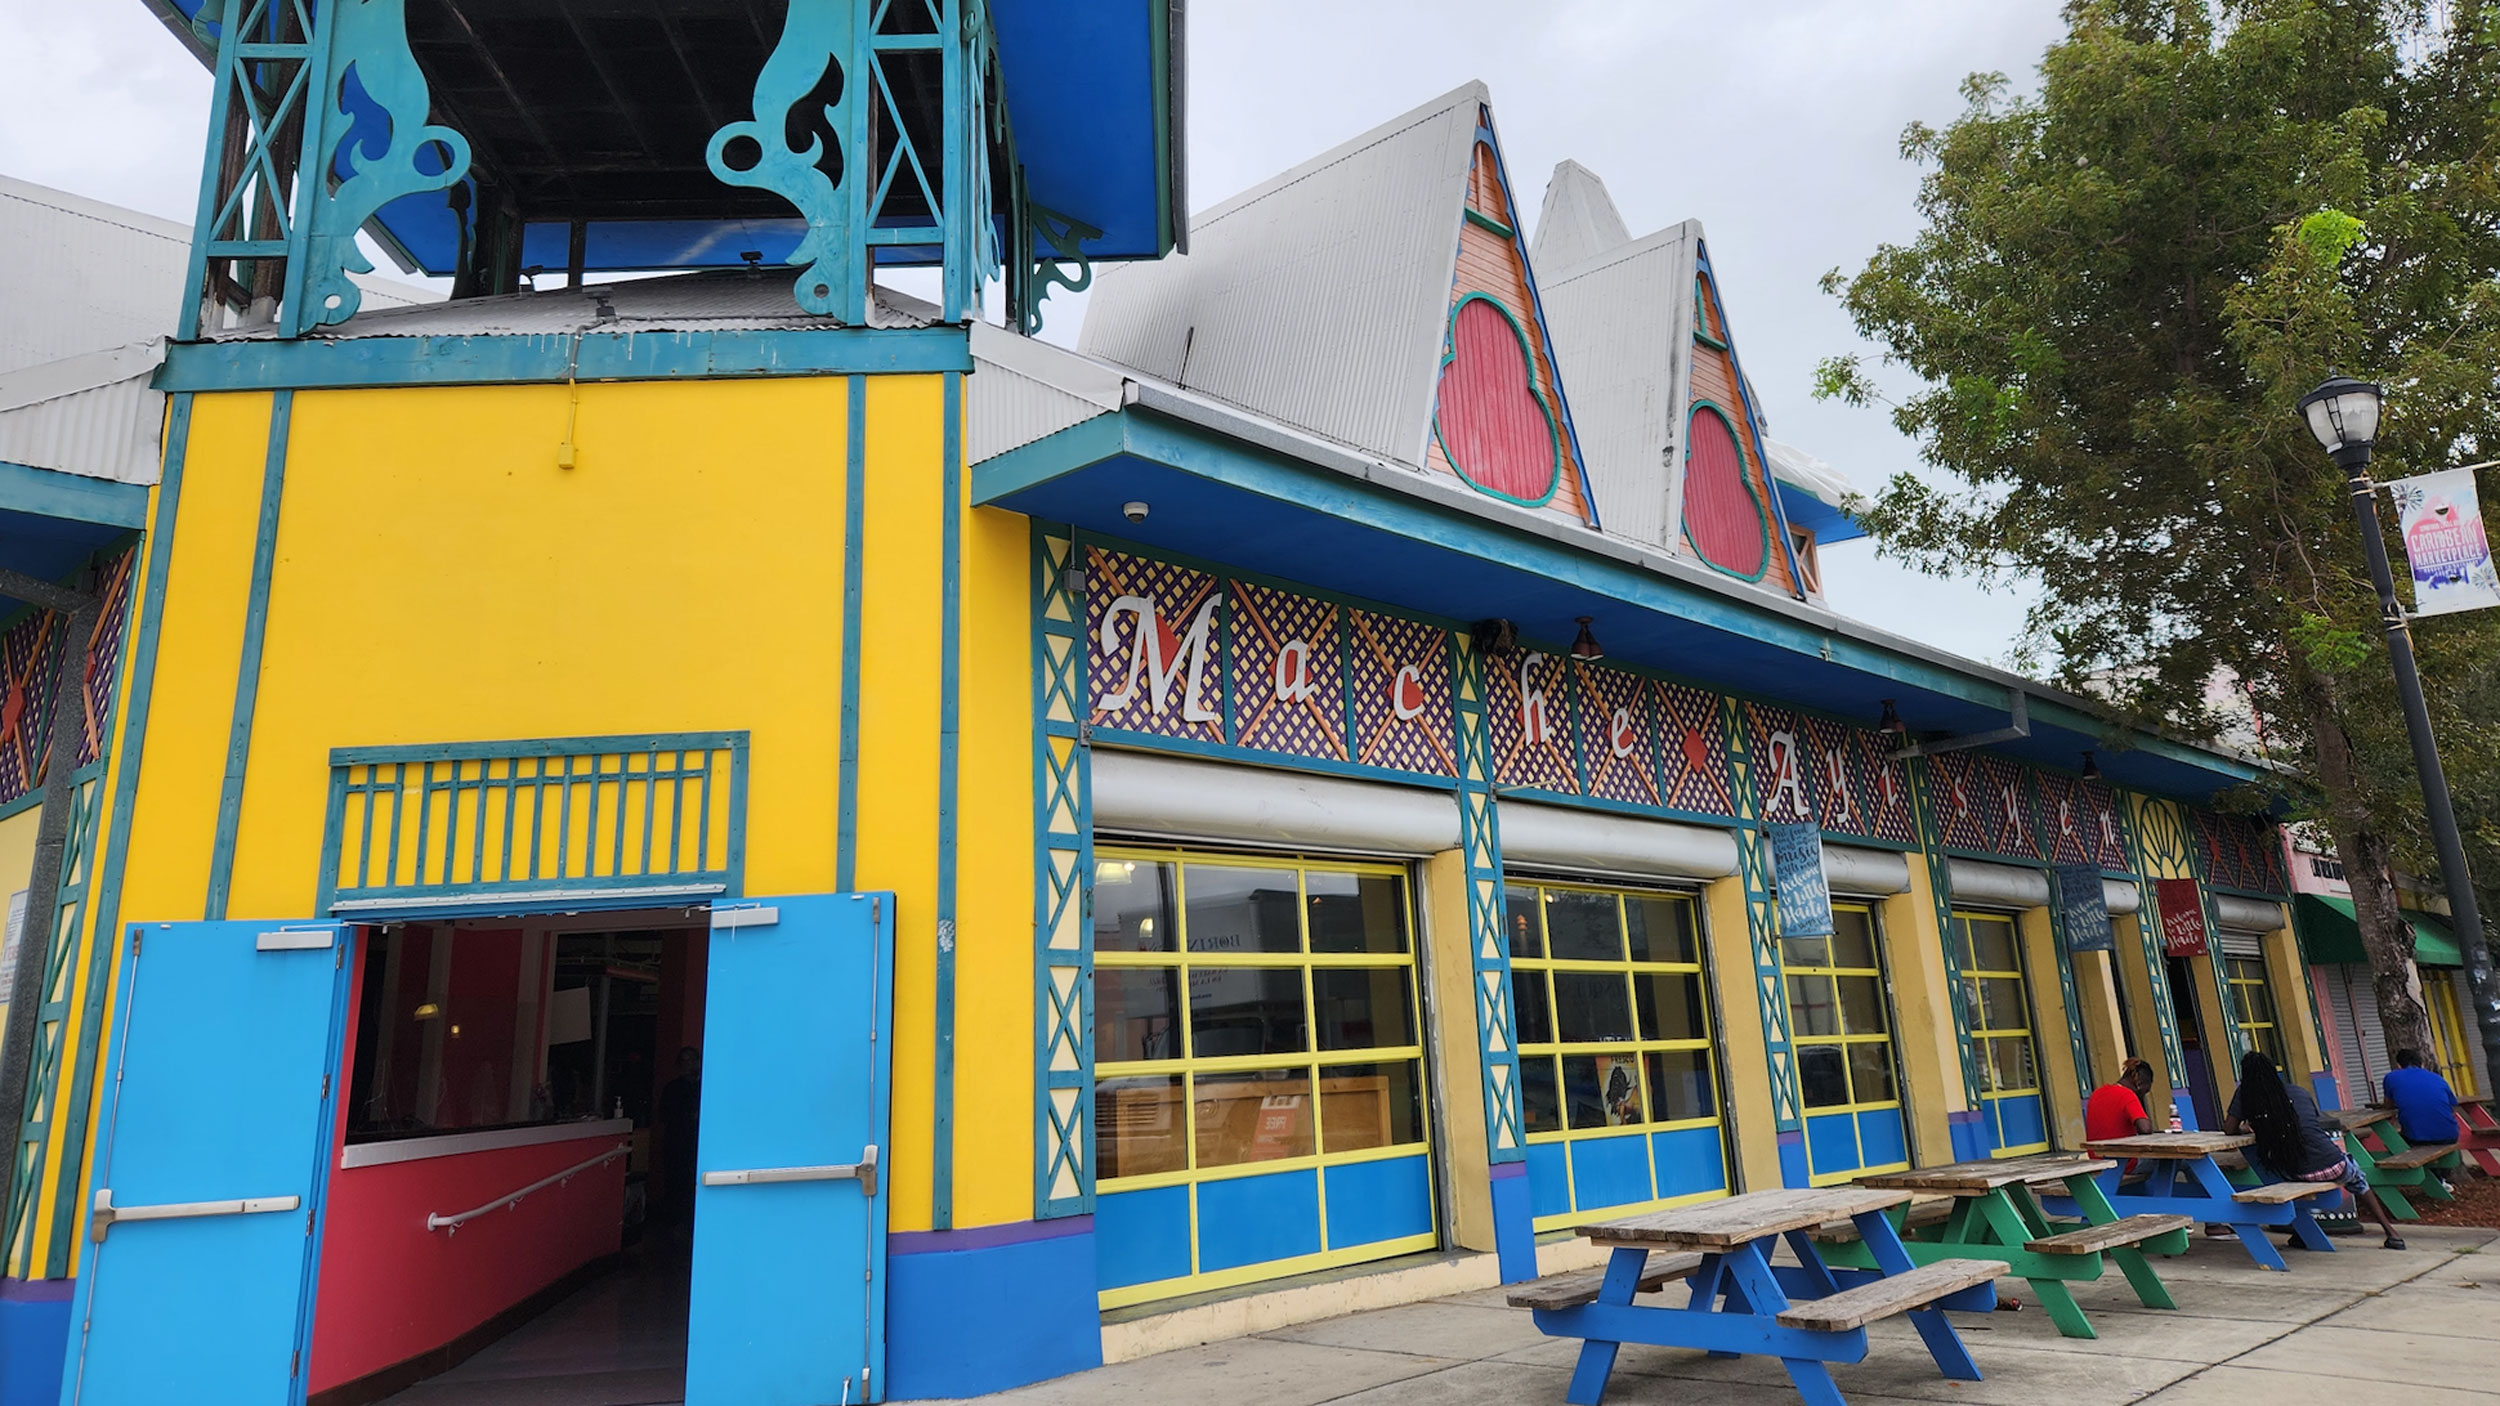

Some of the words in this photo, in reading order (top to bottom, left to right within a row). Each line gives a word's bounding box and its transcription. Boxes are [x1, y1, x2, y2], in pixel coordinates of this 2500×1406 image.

[2411, 525, 2478, 552] CARIBBEAN
[2414, 543, 2482, 567] MARKETPLACE
[1098, 592, 1635, 759] Mache
[1766, 730, 2115, 848] Ayisyen
